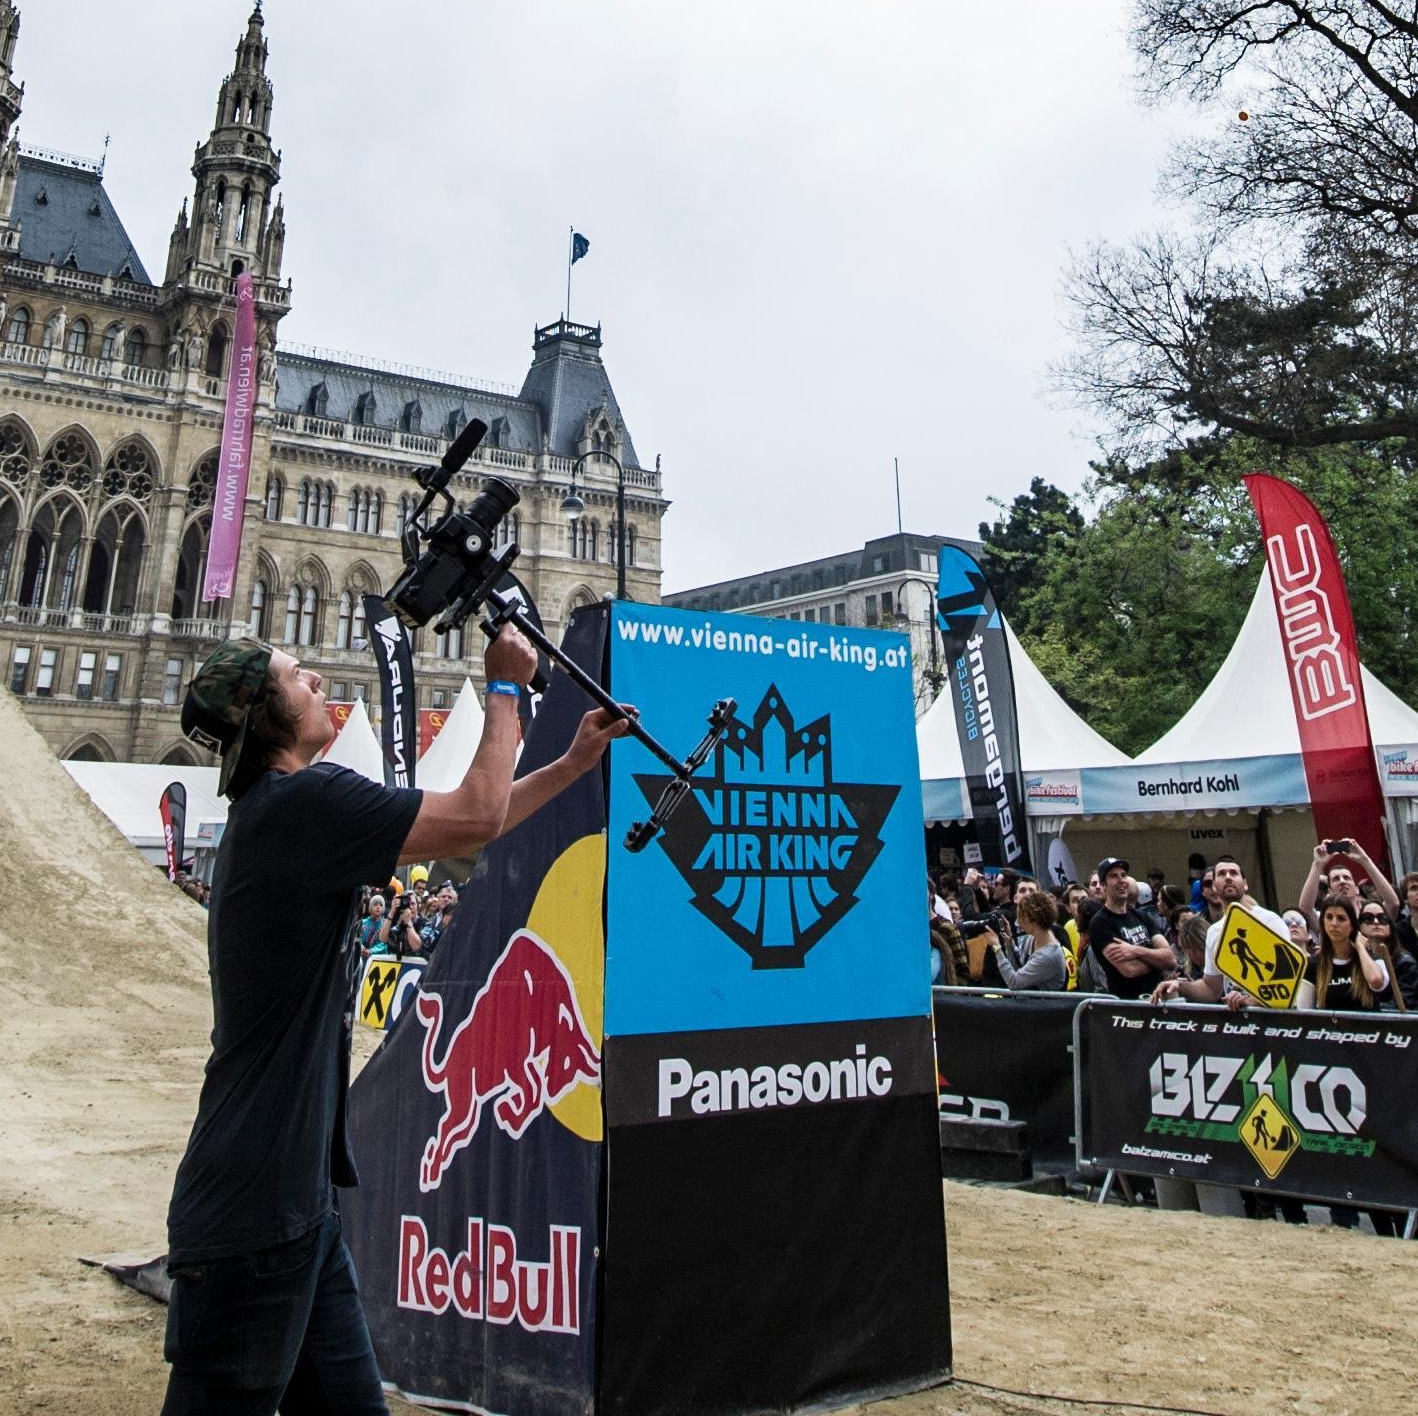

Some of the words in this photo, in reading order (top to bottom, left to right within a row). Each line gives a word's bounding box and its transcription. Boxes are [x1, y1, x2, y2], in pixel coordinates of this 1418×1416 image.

[617, 618, 908, 673] www.vienna-air-king.at
[1137, 776, 1203, 797] Bernhard
[1206, 774, 1240, 793] Kohl
[690, 788, 860, 829] VIENNA
[691, 833, 761, 870] AIR
[769, 834, 859, 870] KING
[1189, 827, 1225, 839] uvex
[1111, 1015, 1143, 1029] This
[1148, 1018, 1198, 1032] track
[1202, 1024, 1218, 1033] is
[1223, 1022, 1261, 1035] built
[1264, 1026, 1303, 1039] and
[1305, 1028, 1380, 1045] shaped
[1384, 1032, 1413, 1048] by
[658, 1043, 893, 1118] Panasonic
[1121, 1143, 1214, 1164] balzamico.at
[397, 1214, 483, 1320] Red
[485, 1222, 581, 1336] Bull
